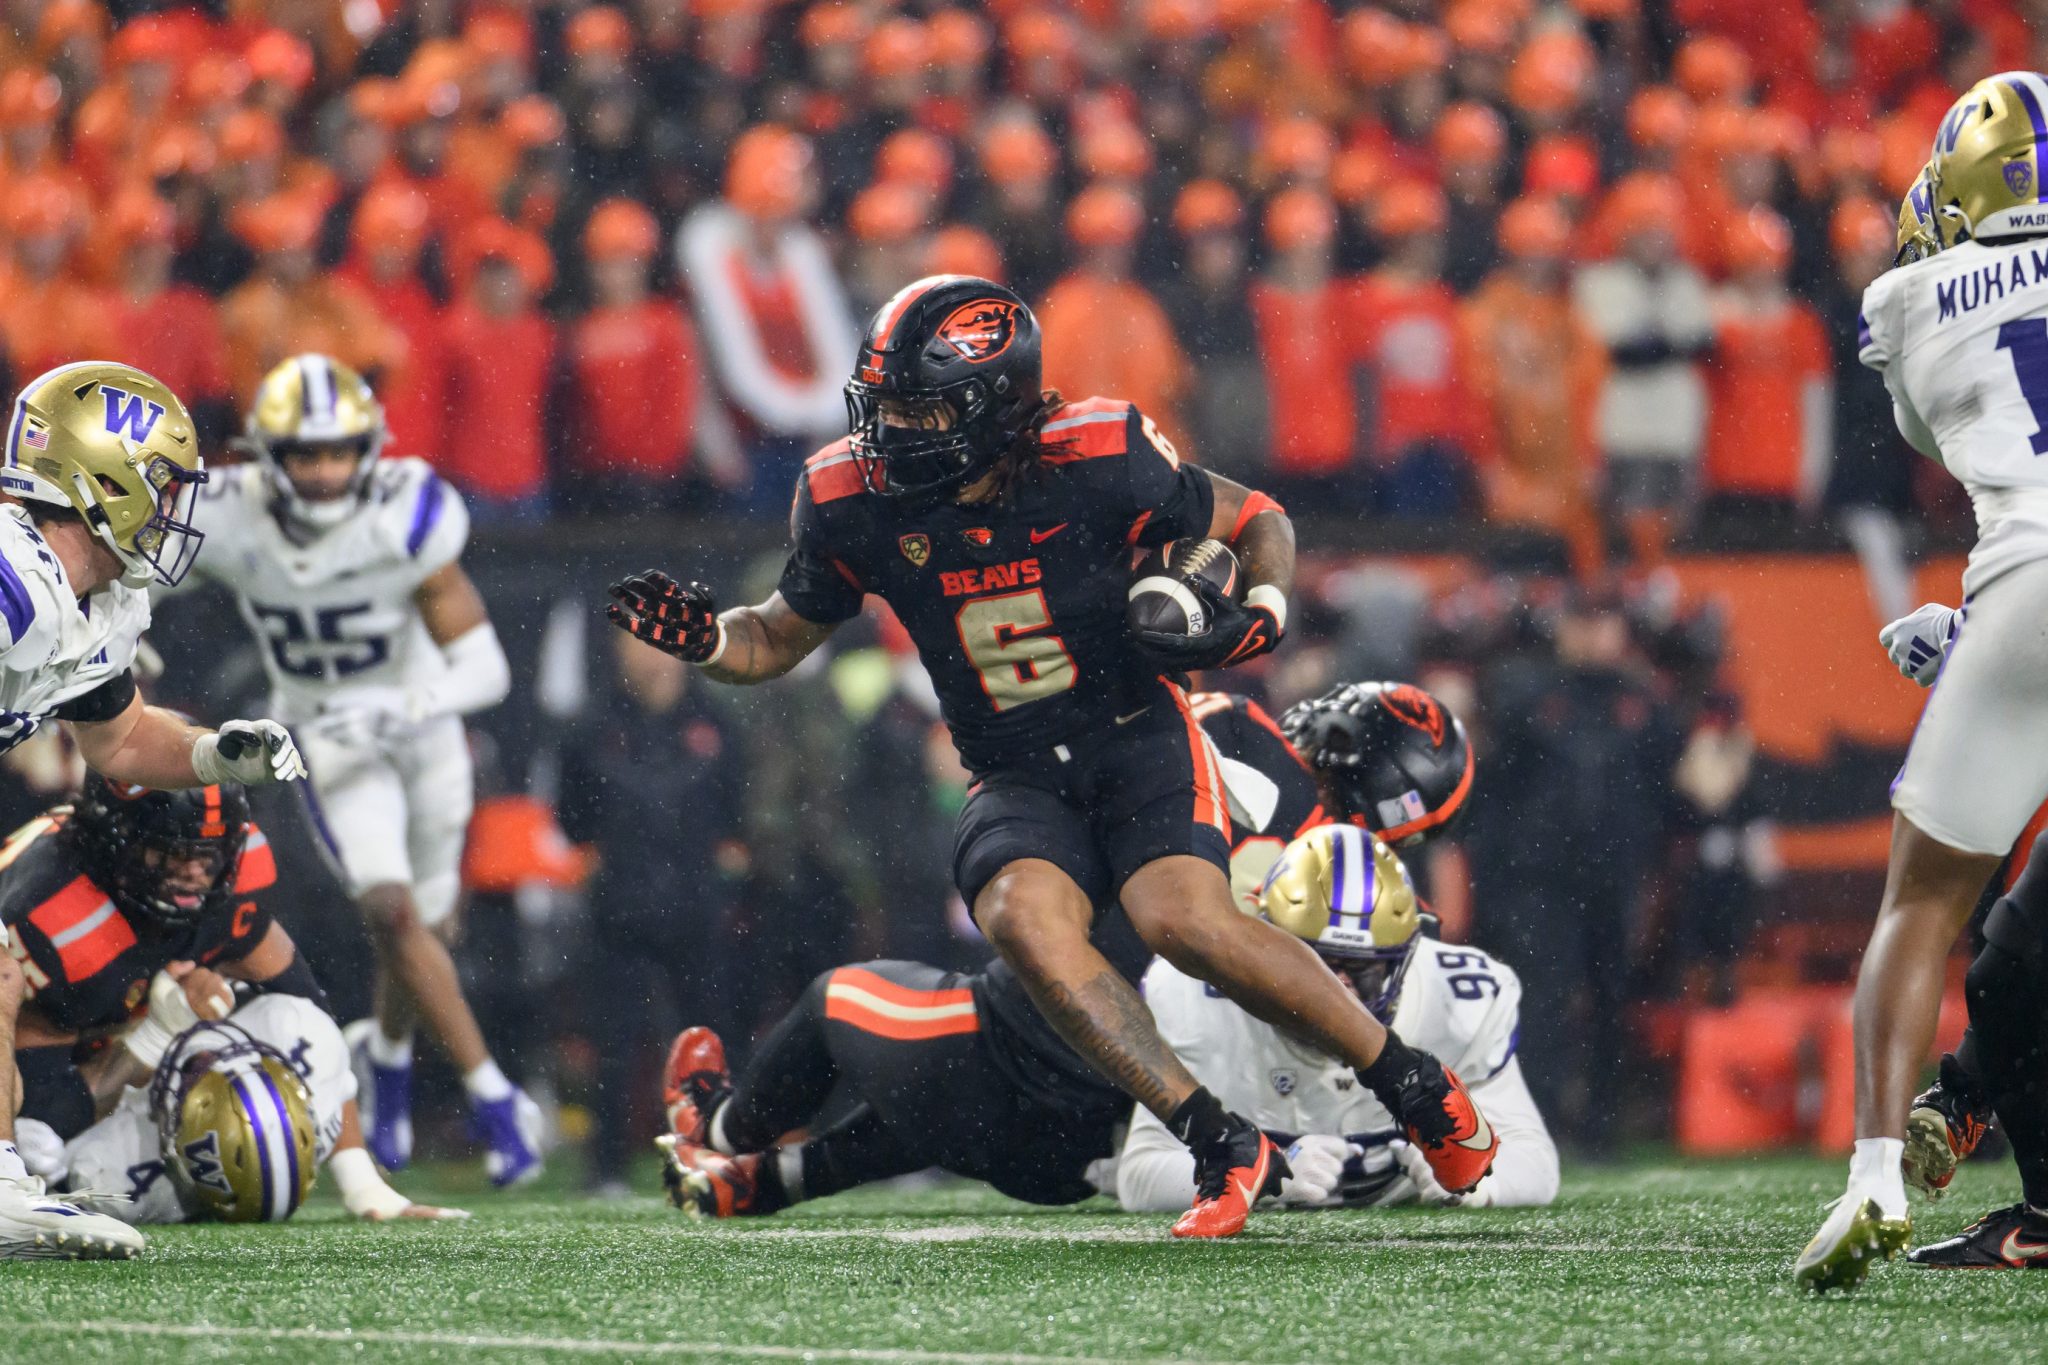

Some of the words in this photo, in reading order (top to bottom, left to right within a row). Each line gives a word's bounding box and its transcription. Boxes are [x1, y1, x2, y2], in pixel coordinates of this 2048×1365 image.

[99, 384, 167, 444] W
[939, 558, 1042, 597] BEAVS
[253, 601, 388, 678] 25
[955, 587, 1078, 713] 6
[231, 901, 257, 939] C
[1334, 1077, 1354, 1092] W
[184, 1130, 233, 1195] W
